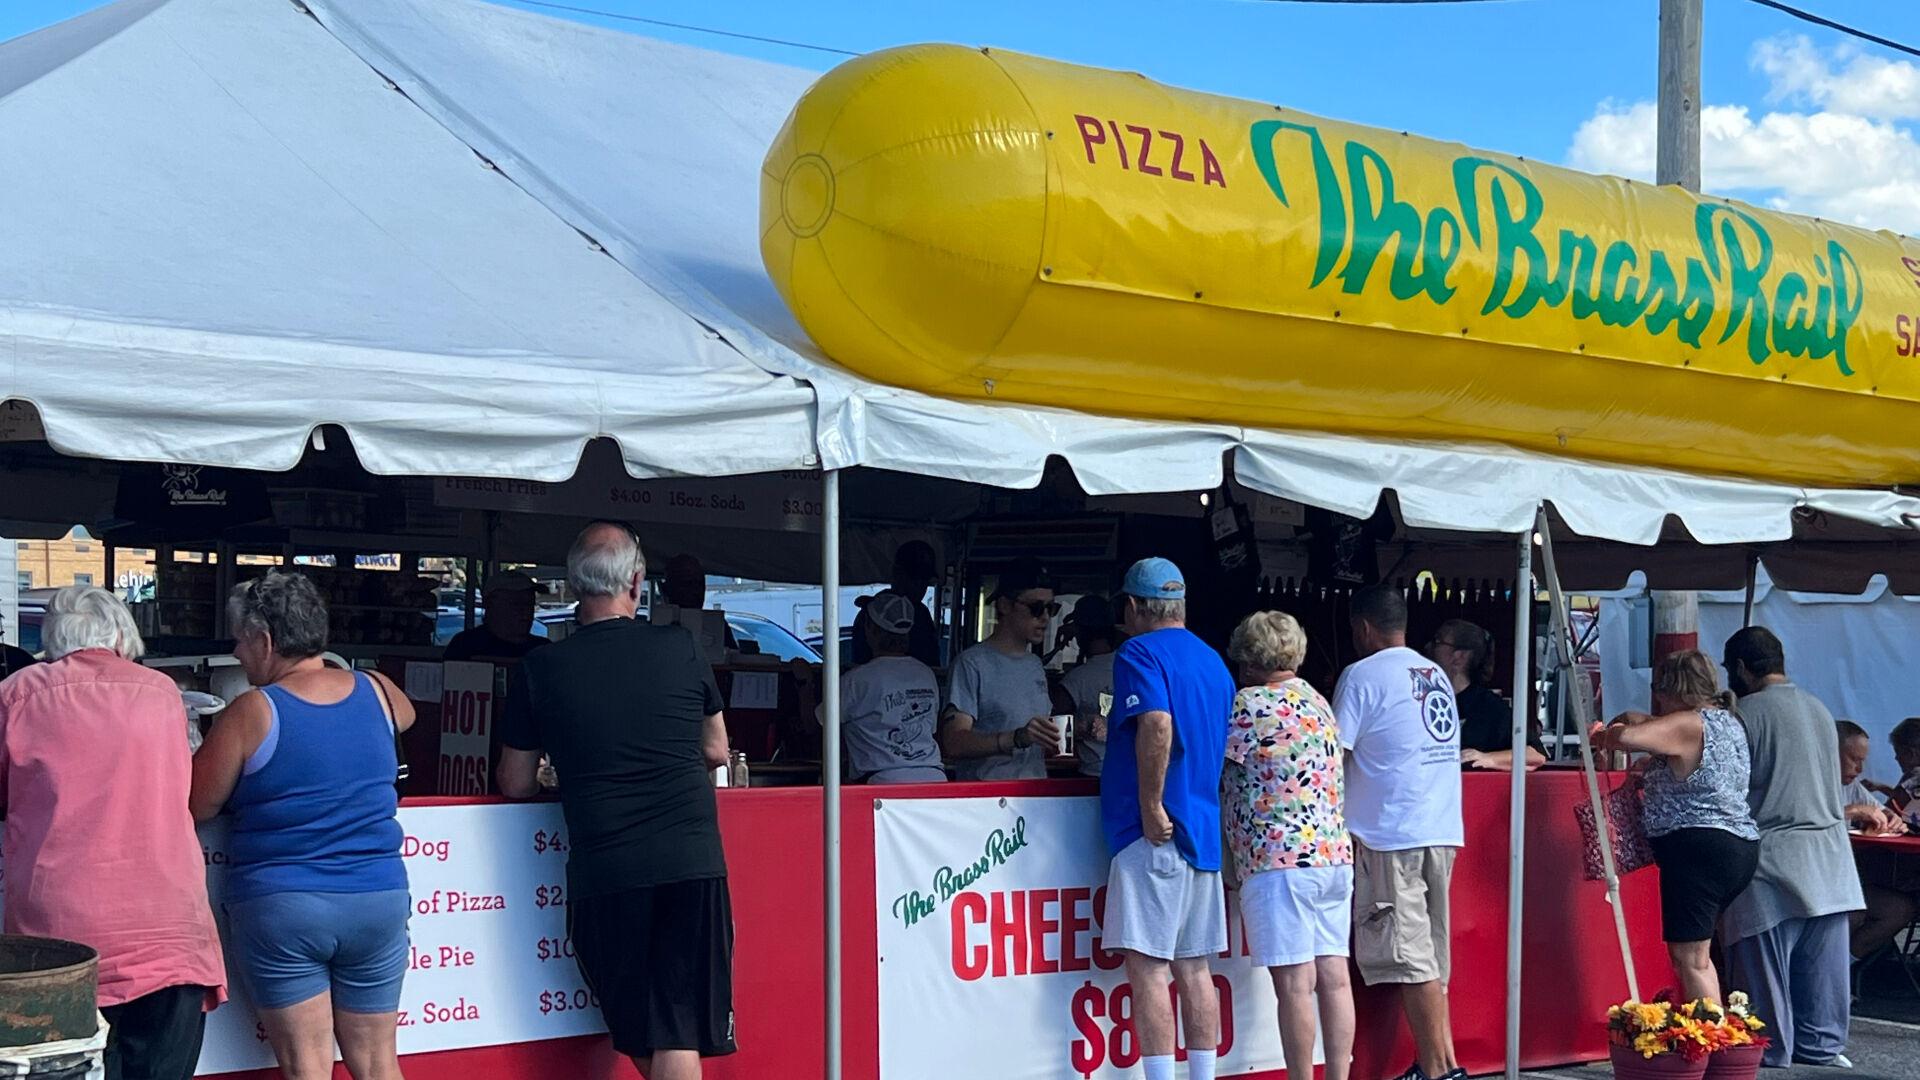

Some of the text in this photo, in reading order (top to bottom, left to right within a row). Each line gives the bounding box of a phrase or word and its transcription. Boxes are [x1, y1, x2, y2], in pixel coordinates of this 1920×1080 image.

[1074, 115, 1227, 188] PIZZA
[1250, 120, 1864, 376] The Brass Rail
[445, 477, 503, 493] French
[508, 479, 547, 496] Fries
[610, 486, 651, 504] $4.00
[711, 494, 746, 511] Soda
[782, 499, 823, 516] $3.00
[443, 690, 491, 736] HOT
[440, 754, 487, 795] DOGS
[402, 830, 569, 861] Dog $4.
[892, 815, 1029, 929] The Brass Rail
[417, 891, 441, 914] of
[446, 892, 506, 912] Pizza
[439, 946, 475, 967] Pie
[423, 998, 480, 1024] Soda
